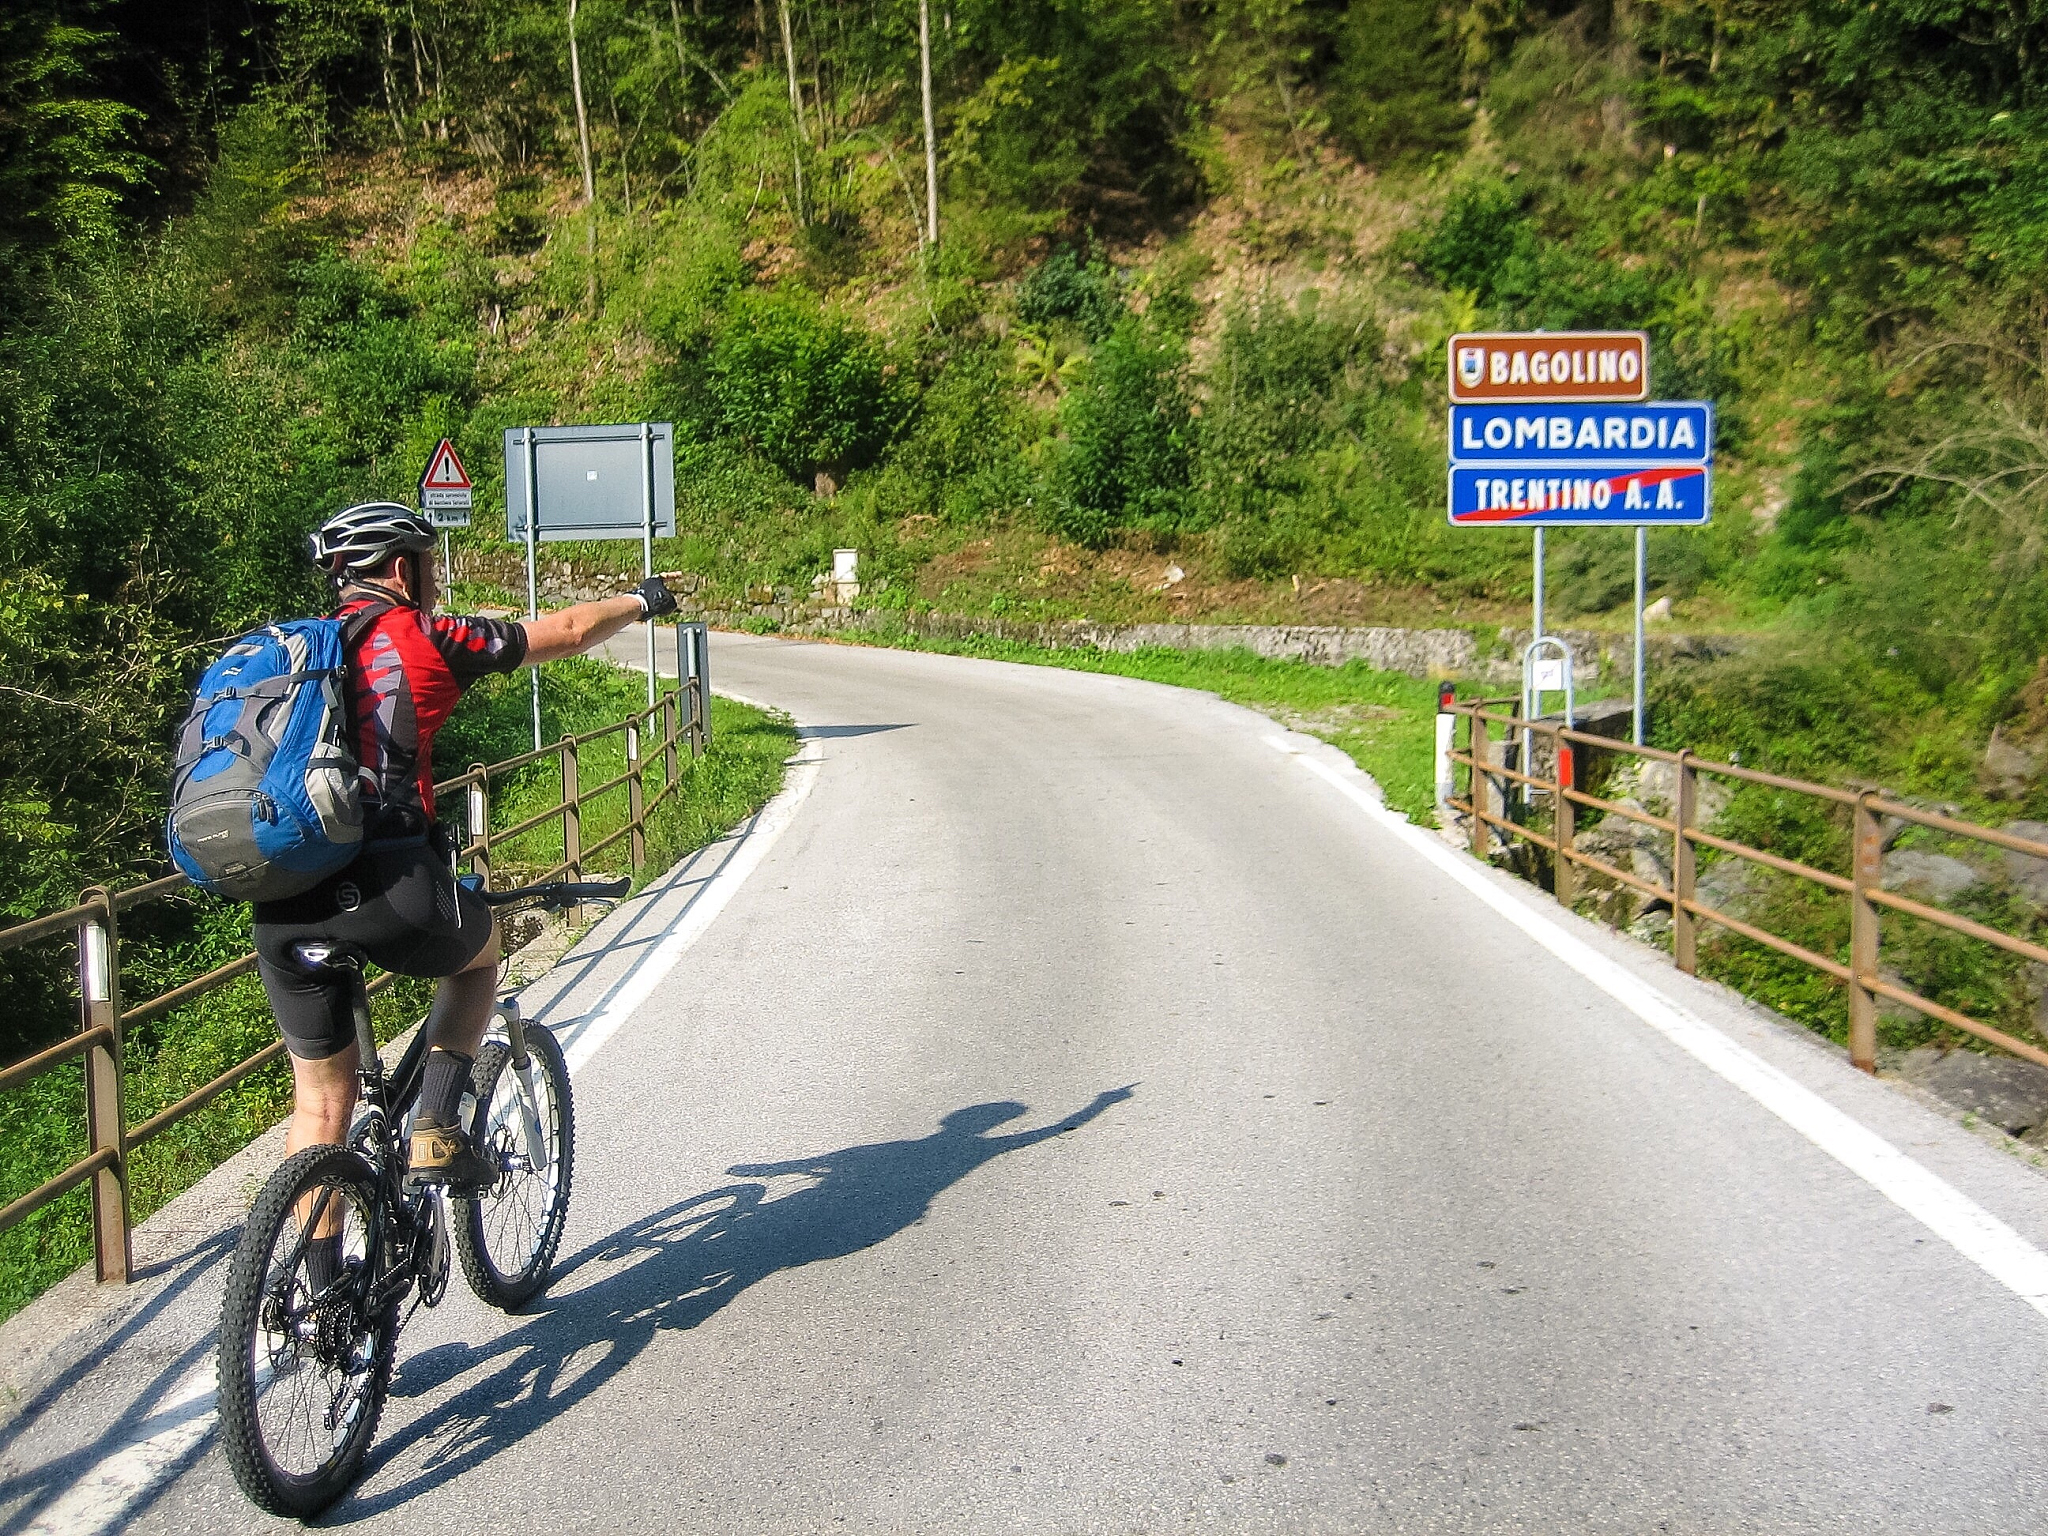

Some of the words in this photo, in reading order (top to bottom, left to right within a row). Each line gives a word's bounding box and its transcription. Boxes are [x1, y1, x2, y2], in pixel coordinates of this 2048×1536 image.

[1489, 350, 1639, 385] BAGOLINO
[1462, 416, 1696, 450] LOMBARDIA
[1475, 478, 1612, 511] TRENTINO
[437, 513, 444, 522] 2
